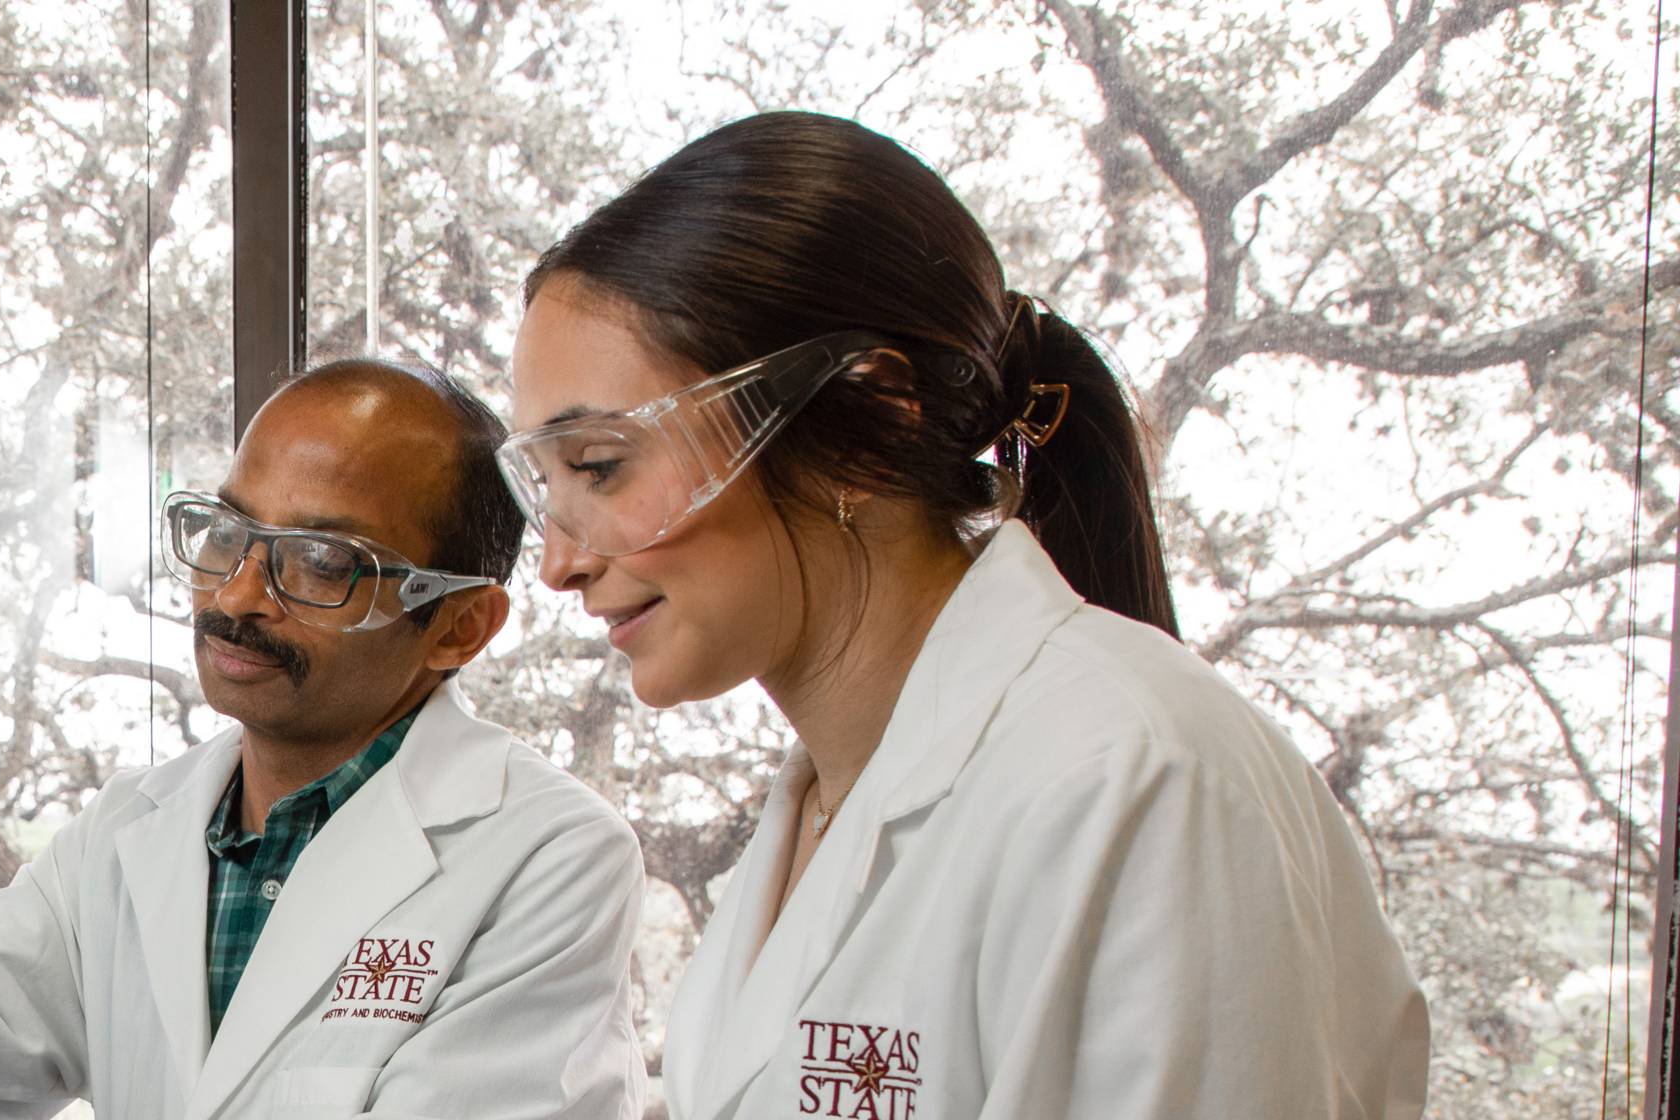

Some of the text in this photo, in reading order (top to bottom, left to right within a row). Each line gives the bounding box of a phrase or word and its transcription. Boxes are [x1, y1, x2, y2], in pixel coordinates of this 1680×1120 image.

[331, 975, 425, 1004] STATE
[351, 1008, 370, 1018] AND
[799, 1020, 920, 1073] TEXAS
